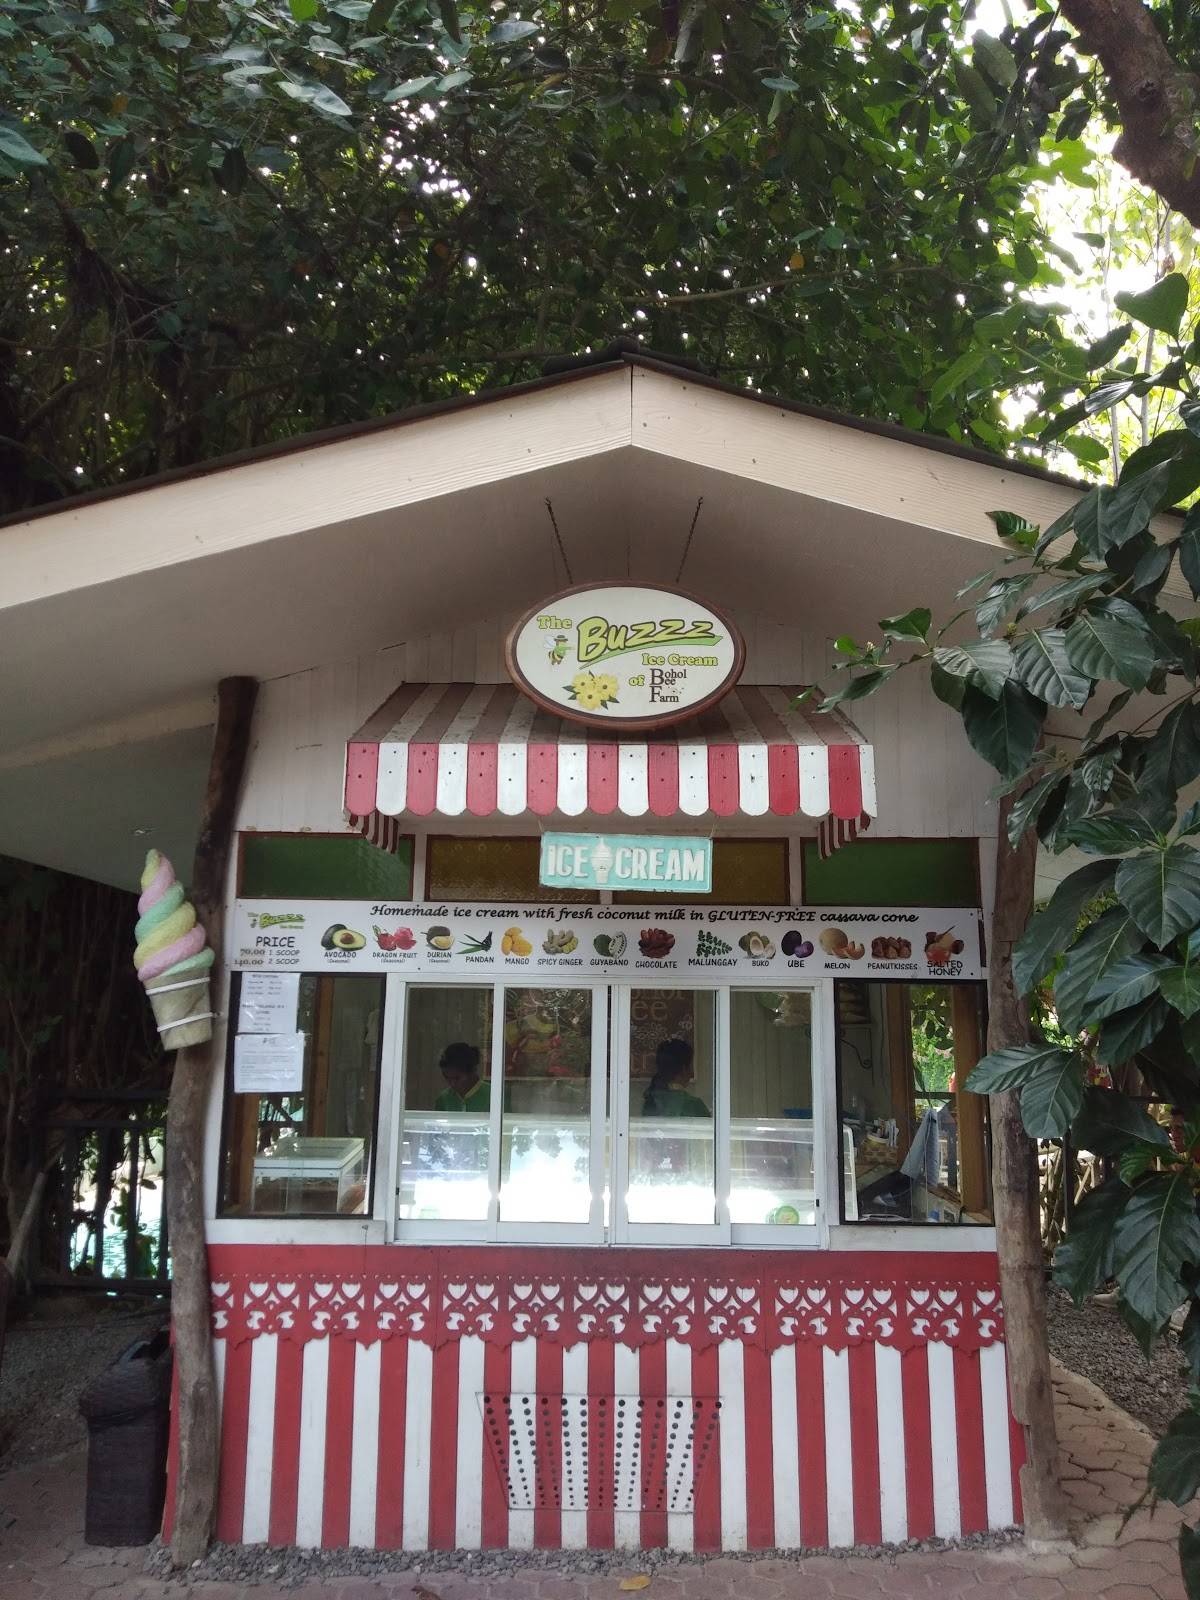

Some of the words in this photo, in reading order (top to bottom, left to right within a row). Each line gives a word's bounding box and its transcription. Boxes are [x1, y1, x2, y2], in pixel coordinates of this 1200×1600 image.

[537, 616, 572, 629] The
[577, 616, 715, 662] Buzzz
[642, 654, 665, 666] Ice
[668, 654, 718, 666] Cream
[629, 675, 645, 686] of
[650, 686, 679, 703] Farm
[547, 845, 589, 877] ICE
[615, 847, 705, 881] CREAM
[371, 905, 449, 918] Homemade
[454, 907, 471, 917] ice
[476, 909, 519, 918] cream
[523, 907, 555, 919] with
[556, 907, 593, 922] fresh
[597, 910, 650, 921] coconut
[654, 908, 685, 921] milk
[690, 909, 704, 921] in
[708, 909, 816, 923] GLUTEN-FREE
[820, 911, 880, 923] cassava
[882, 912, 918, 923] cone
[256, 936, 295, 948] PRICE
[324, 951, 357, 959] AVOCADO
[537, 958, 557, 966] SPICY
[635, 961, 678, 969] CHOCOLATE
[689, 959, 737, 967] MALUNGGAY
[787, 960, 805, 968] UBE
[927, 960, 963, 969] SALTED
[929, 967, 962, 976] HONEY
